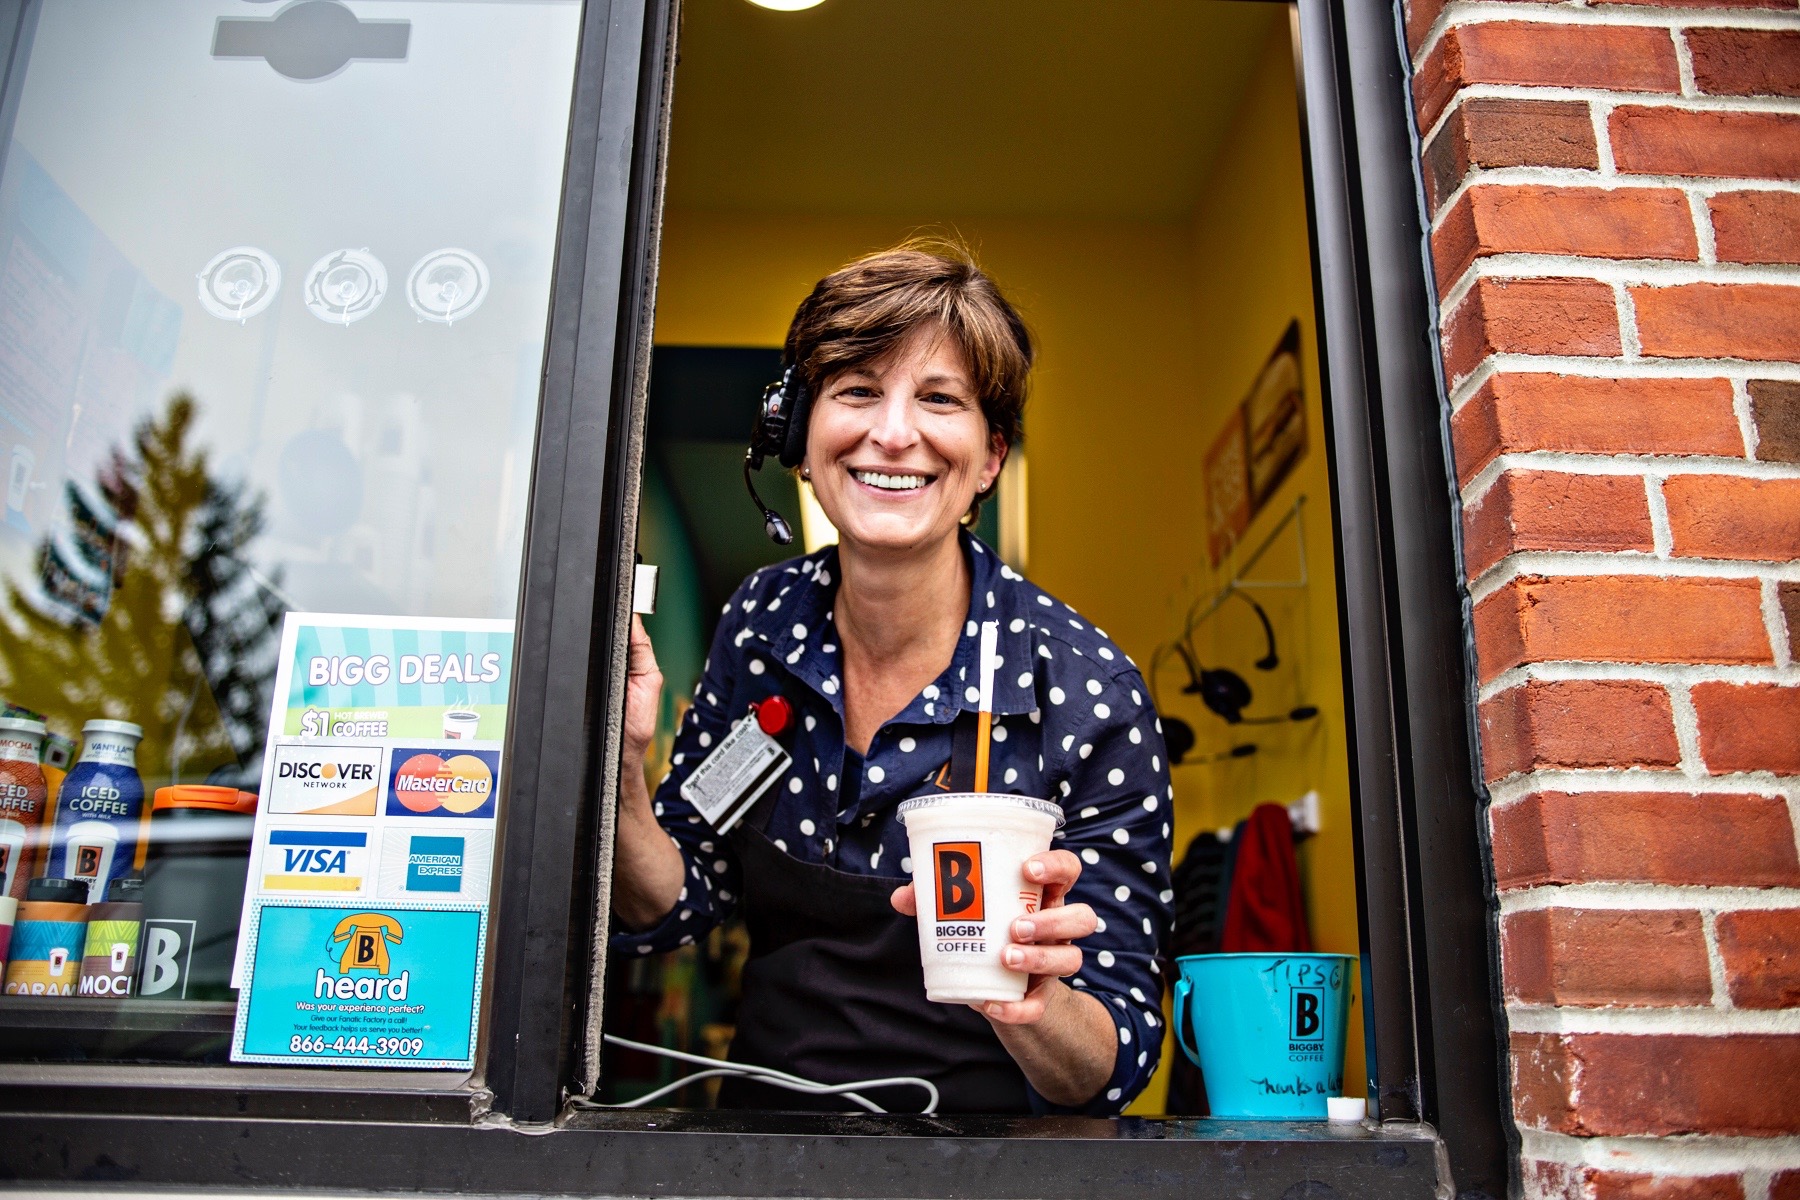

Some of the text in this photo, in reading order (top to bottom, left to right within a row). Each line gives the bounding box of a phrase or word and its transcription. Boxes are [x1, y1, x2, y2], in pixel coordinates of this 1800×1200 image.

[309, 653, 501, 686] BIGG DEALS
[300, 708, 330, 737] $1
[334, 712, 353, 720] HOT
[332, 721, 388, 737] COFFEE
[0, 740, 32, 750] MOCHA
[91, 743, 127, 753] VANILLA
[700, 763, 712, 776] this
[711, 748, 726, 765] card
[723, 738, 736, 751] like
[279, 762, 373, 780] DISCOVER
[303, 781, 347, 789] NETWORK
[396, 774, 490, 795] MasterCard
[81, 786, 120, 801] ICED
[69, 799, 128, 815] COFFEE
[98, 812, 112, 820] MILK
[79, 849, 97, 874] B
[283, 849, 347, 874] VISA
[409, 854, 460, 865] AMERICAN
[418, 866, 462, 876] EXPRESS
[938, 851, 976, 915] B
[936, 926, 985, 937] BIGGBY
[357, 934, 375, 963] B
[937, 942, 986, 953] COFFEE
[141, 928, 181, 996] B
[1262, 959, 1326, 991] TIPS
[314, 968, 409, 1001] heard
[296, 1002, 425, 1014] Was your experience perfect?
[1296, 992, 1320, 1037] B
[339, 1015, 361, 1023] Fanatic
[363, 1016, 387, 1024] Factory
[394, 1016, 408, 1024] call!
[309, 1024, 339, 1032] feedback
[340, 1025, 358, 1033] helps
[387, 1026, 400, 1034] you
[401, 1026, 423, 1034] better!
[289, 1034, 424, 1056] 866-444-3909
[1289, 1043, 1324, 1051] BIGGBY
[1289, 1054, 1324, 1062] COFFEE
